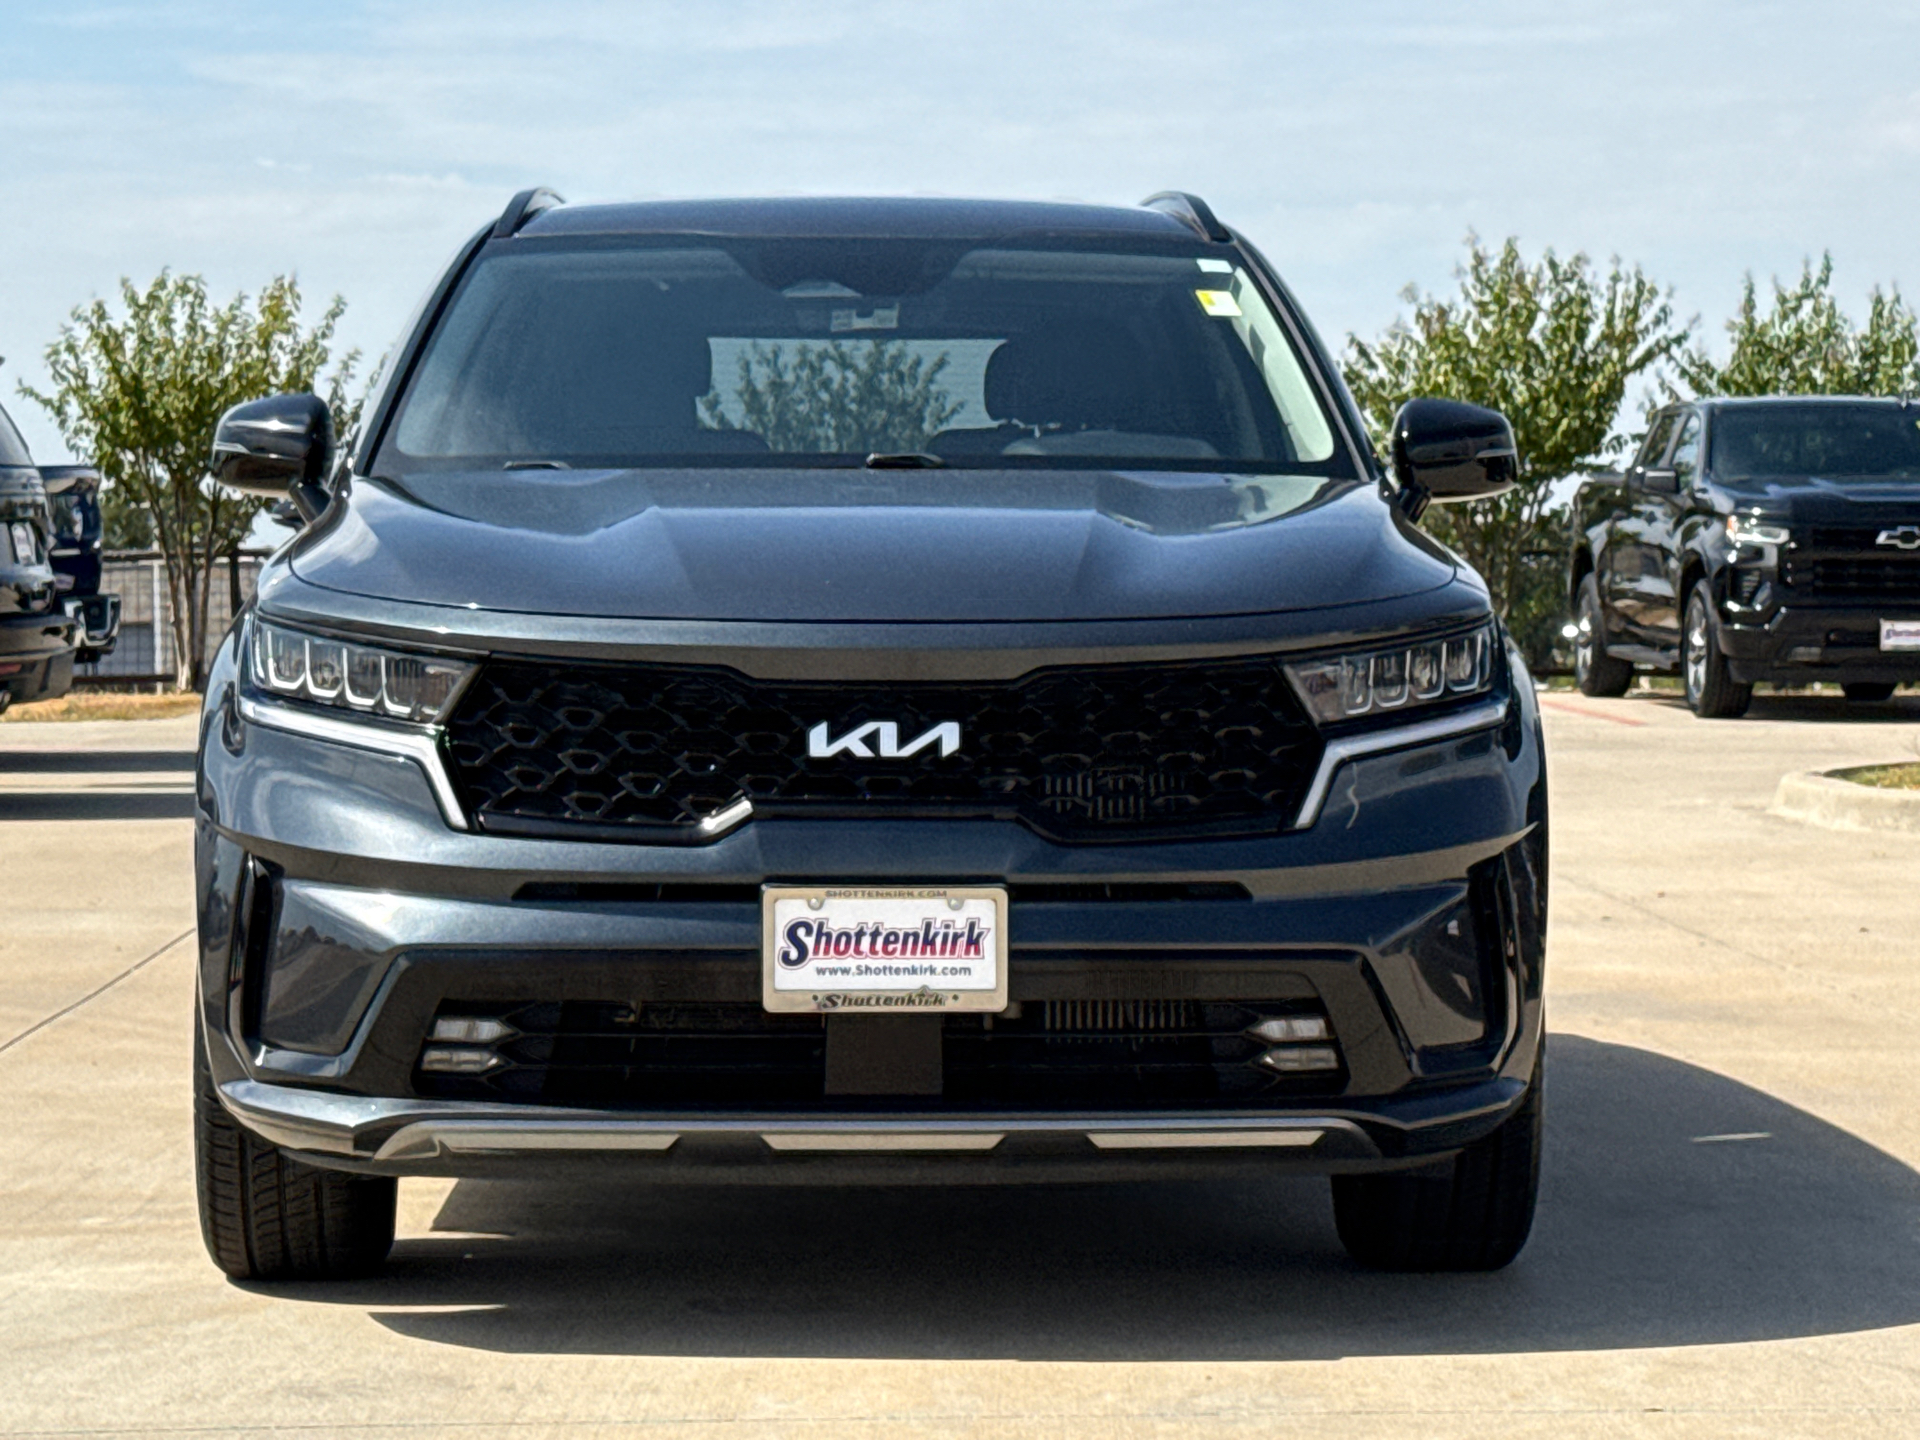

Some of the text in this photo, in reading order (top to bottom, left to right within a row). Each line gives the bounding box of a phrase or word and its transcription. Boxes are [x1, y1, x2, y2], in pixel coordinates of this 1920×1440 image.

[809, 721, 960, 757] KIA
[779, 918, 991, 969] Shottenkirk
[816, 964, 971, 976] www.Shottenkirk.com
